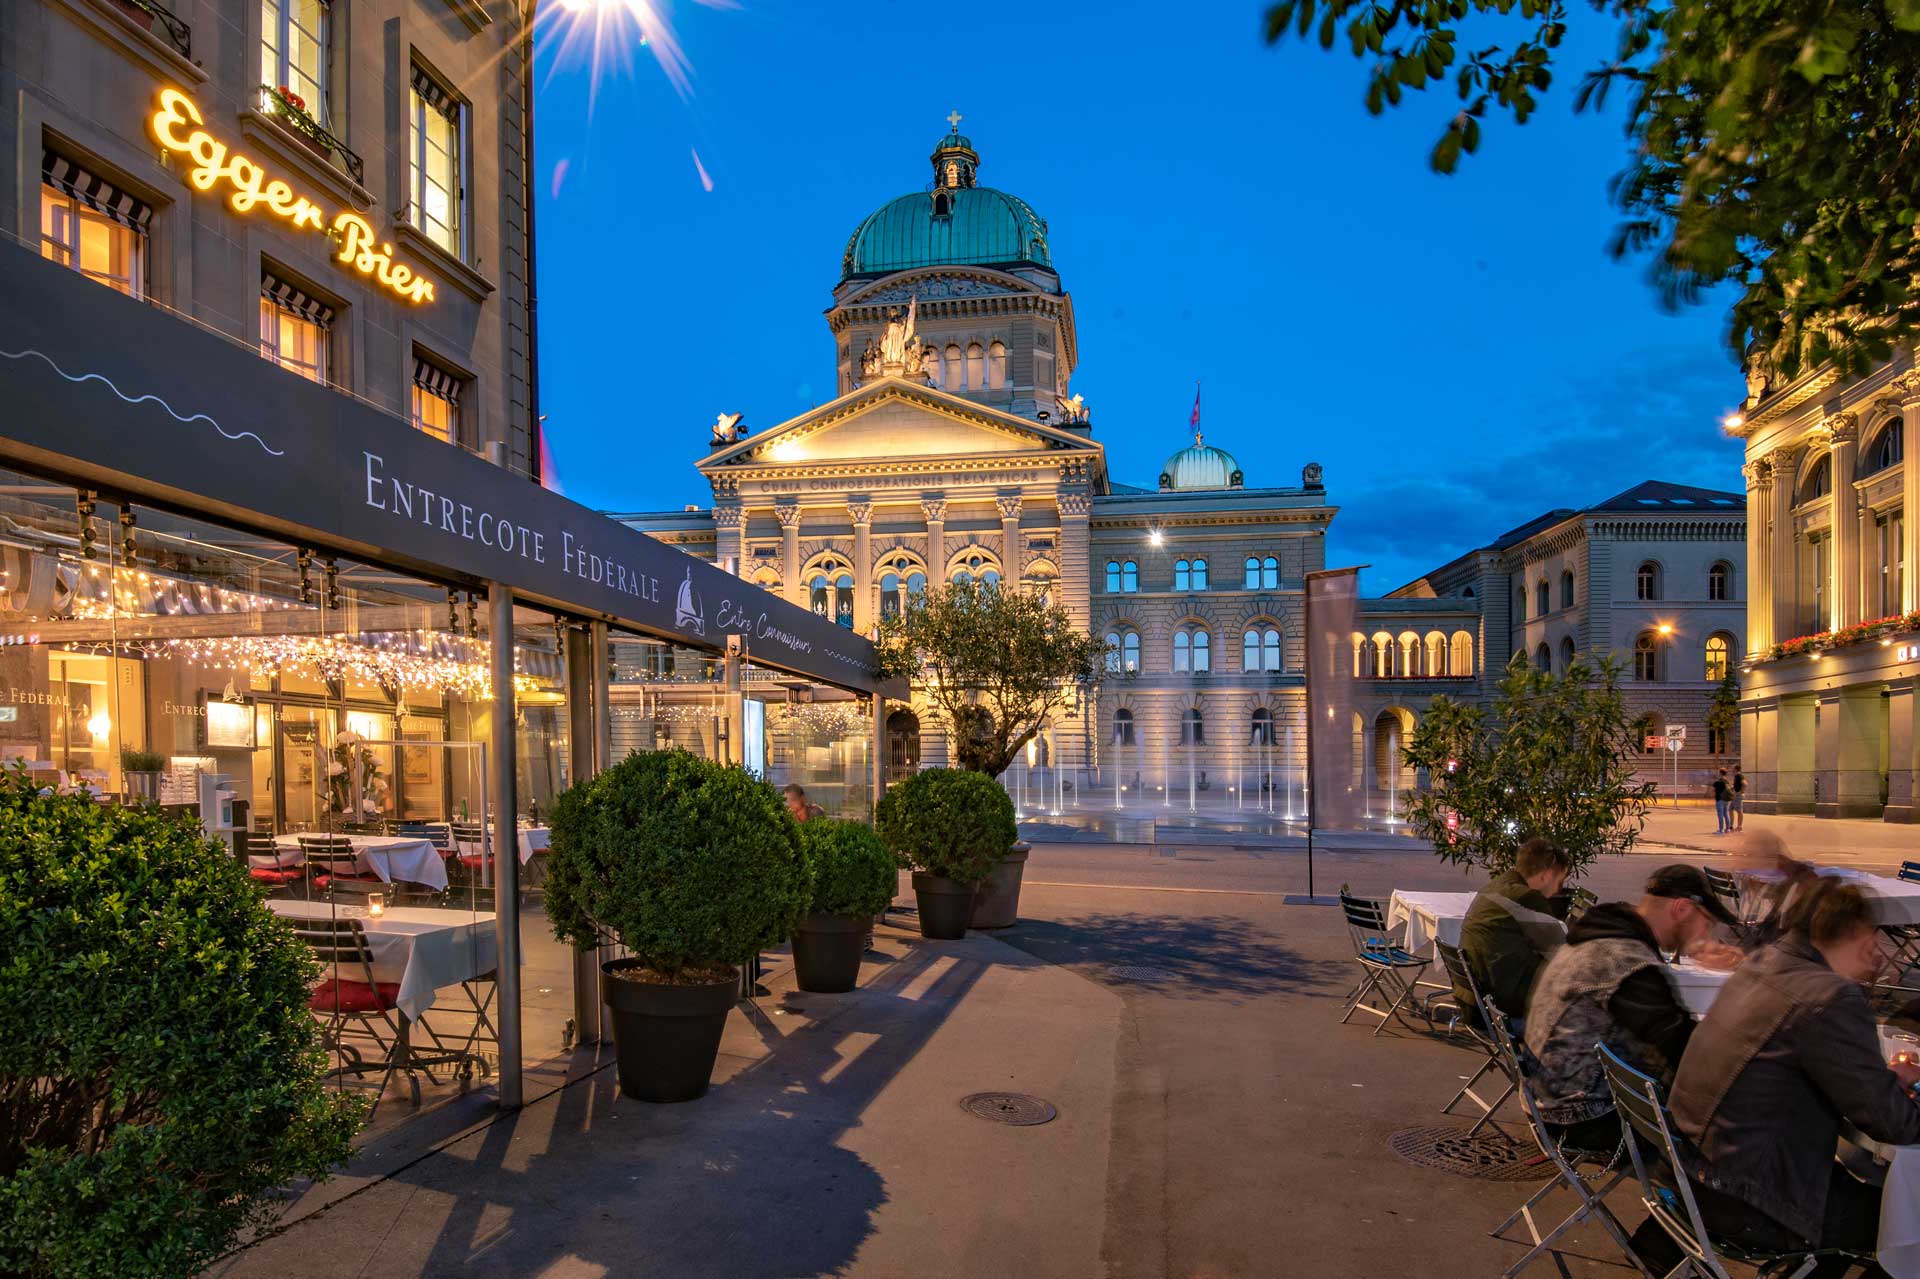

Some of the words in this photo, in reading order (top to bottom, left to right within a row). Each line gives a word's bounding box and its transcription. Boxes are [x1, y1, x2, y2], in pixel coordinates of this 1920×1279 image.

[153, 88, 322, 230] Egger
[334, 213, 434, 303] Bier
[760, 481, 802, 493] CURIA
[952, 470, 1039, 485] HELVETICAE
[561, 530, 660, 604] FÉDÉRALE
[716, 599, 752, 632] Entre
